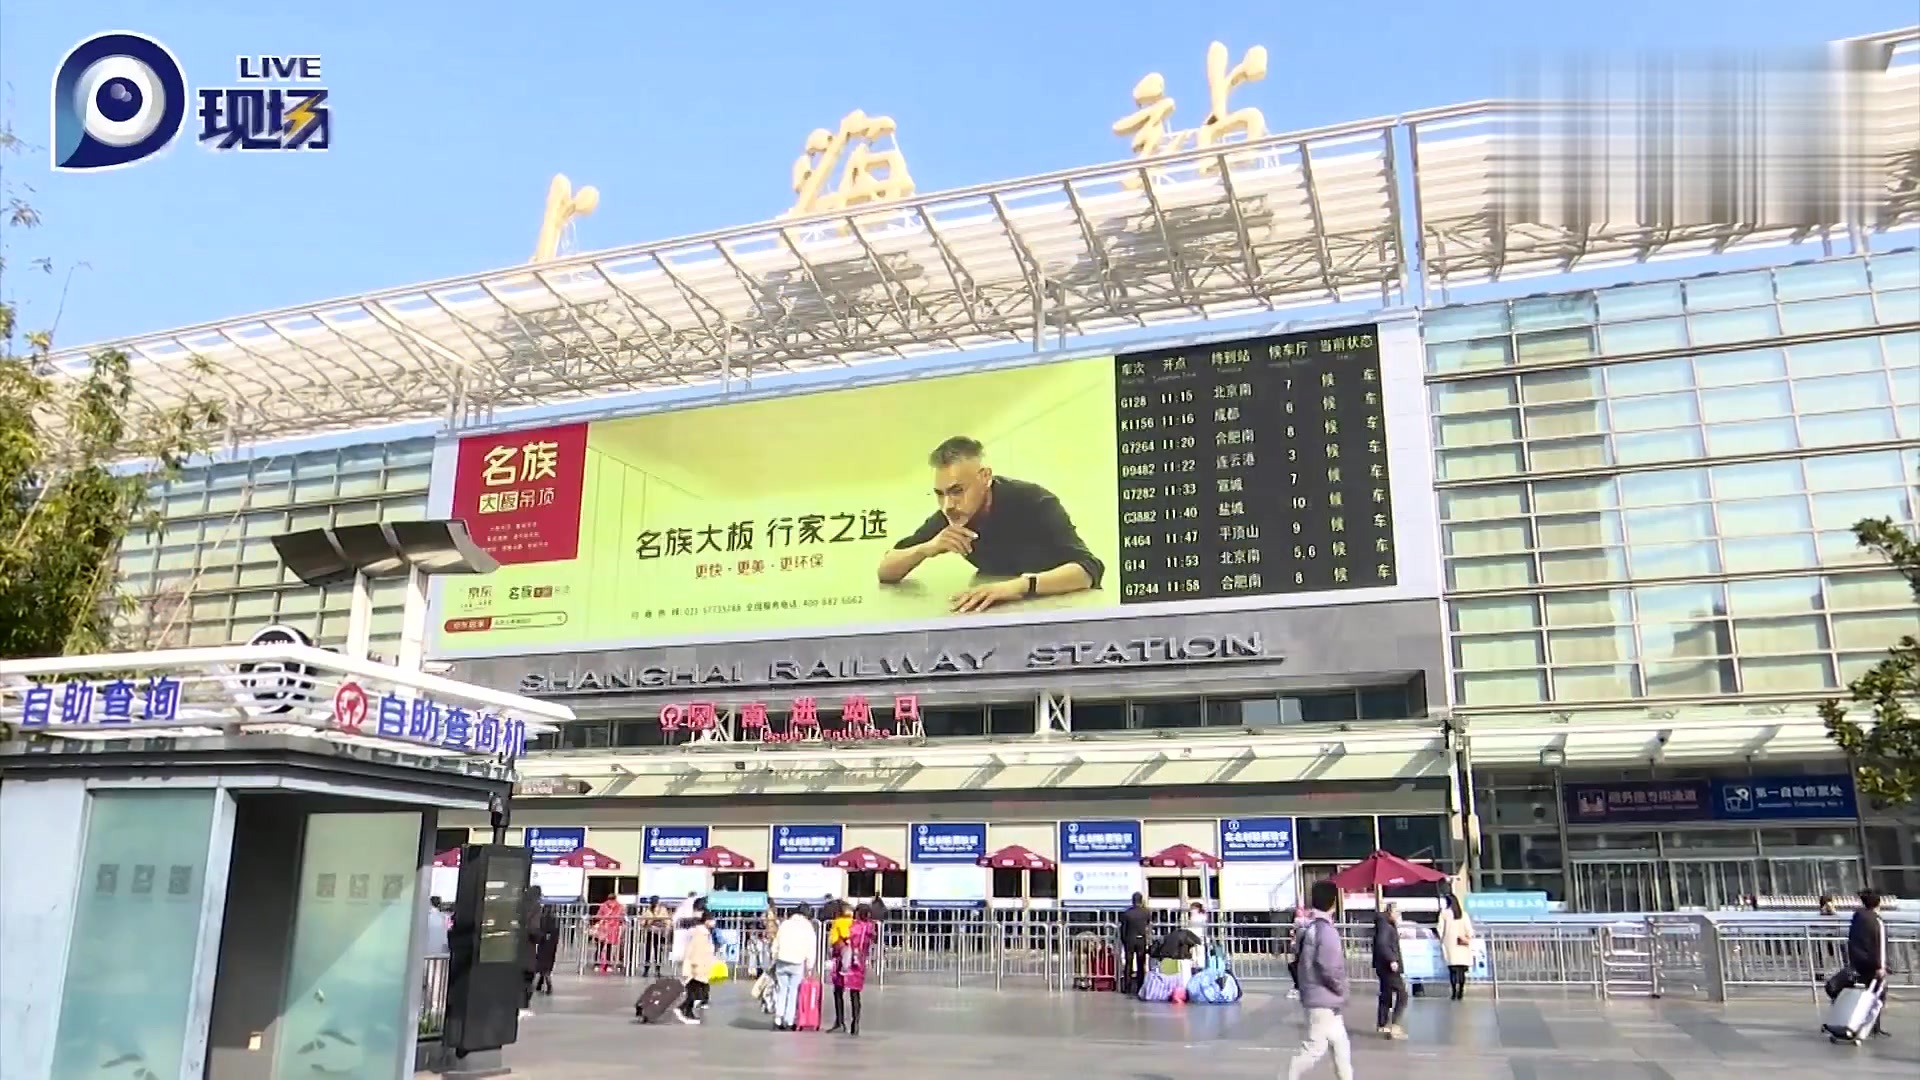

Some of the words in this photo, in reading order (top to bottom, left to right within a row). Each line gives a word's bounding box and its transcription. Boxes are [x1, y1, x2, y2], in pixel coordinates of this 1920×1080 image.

[1121, 361, 1146, 375] 车次
[1162, 357, 1187, 372] 开点
[1268, 341, 1308, 360] 候车厅
[1320, 335, 1373, 352] 当前状态
[1120, 396, 1148, 408] G128
[1161, 389, 1193, 404] 11:15
[1213, 382, 1252, 399] 北京南
[1284, 379, 1292, 391] 7
[1121, 417, 1155, 431] K1156
[1162, 413, 1195, 428] 11:16
[1214, 407, 1240, 422] 成都
[1286, 401, 1293, 414] 6
[1163, 435, 1196, 450] 11:20
[1215, 429, 1255, 447] 合肥南
[1286, 425, 1295, 438] 8
[480, 440, 559, 487] 名族
[1121, 463, 1155, 477] D9482
[1163, 459, 1196, 472] 11:22
[1288, 448, 1296, 461] 3
[1164, 483, 1197, 496] 11:33
[1290, 473, 1298, 485] 7
[478, 487, 556, 514] 大板吊顶
[1165, 505, 1198, 520] 11:40
[1218, 500, 1245, 516] 盐城
[1292, 496, 1306, 509] 10
[635, 520, 755, 560] 名族大板
[766, 508, 889, 547] 行家之选
[1124, 535, 1152, 548] K464
[1165, 529, 1199, 544] 11:47
[1219, 523, 1259, 541] 平顶山
[1292, 521, 1301, 534] 9
[1124, 559, 1146, 572] G14
[1166, 554, 1199, 568] 11:53
[1220, 547, 1261, 564] 北京南
[1125, 583, 1159, 596] G7244
[1167, 579, 1200, 592] 11:58
[1221, 571, 1262, 590] 合肥南
[1295, 571, 1304, 584] 8
[519, 660, 744, 692] SHANGHAI
[769, 647, 996, 681] RAILWAY
[1027, 631, 1263, 668] STATION
[22, 675, 182, 727] 自助查询
[376, 692, 527, 756] 自助查询机
[1755, 784, 1844, 799] 第一自助售票处
